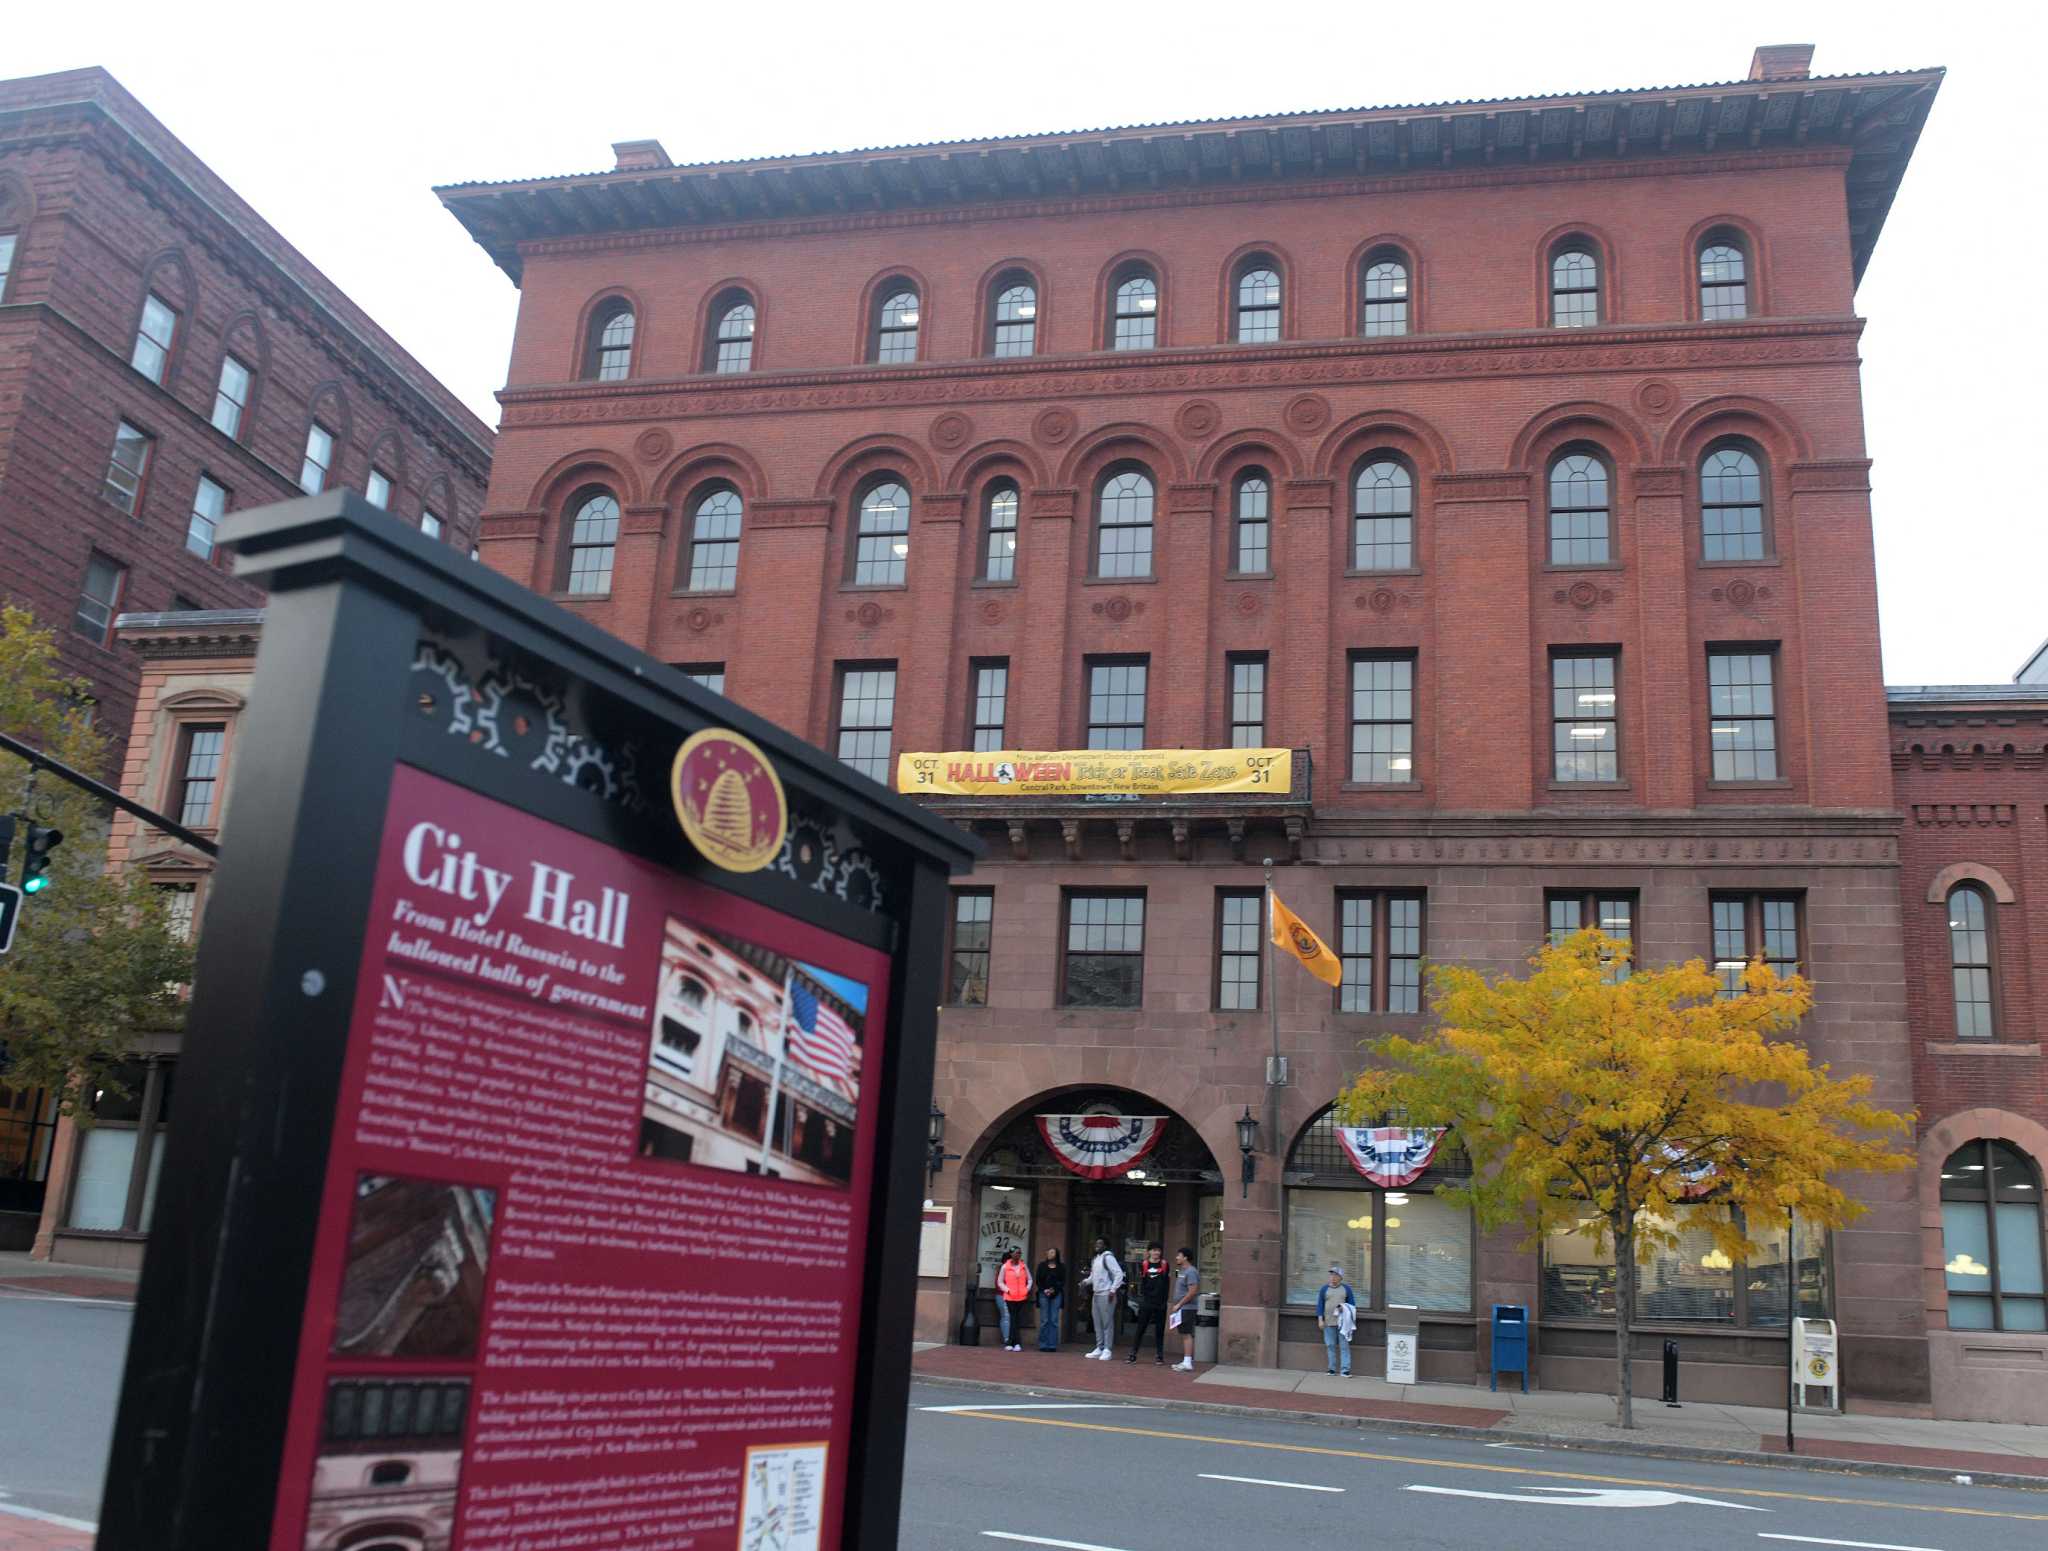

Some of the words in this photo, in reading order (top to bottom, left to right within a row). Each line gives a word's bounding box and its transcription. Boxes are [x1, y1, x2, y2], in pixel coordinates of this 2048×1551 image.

[916, 771, 934, 784] 31
[1168, 761, 1197, 779] Safe
[1199, 761, 1238, 780] Zone
[1251, 770, 1270, 783] 31
[1020, 783, 1048, 791] Central
[404, 821, 513, 927] City
[523, 860, 630, 949] Hall
[393, 899, 447, 933] From
[451, 916, 504, 950] Hotel
[505, 932, 578, 972] Russwin
[579, 960, 598, 978] to
[599, 964, 626, 986] the
[388, 931, 479, 974] hallowed
[478, 957, 525, 988] halls
[524, 973, 551, 998] of
[548, 983, 647, 1021] government
[981, 1221, 1001, 1238] CITY
[995, 1236, 1010, 1249] 27
